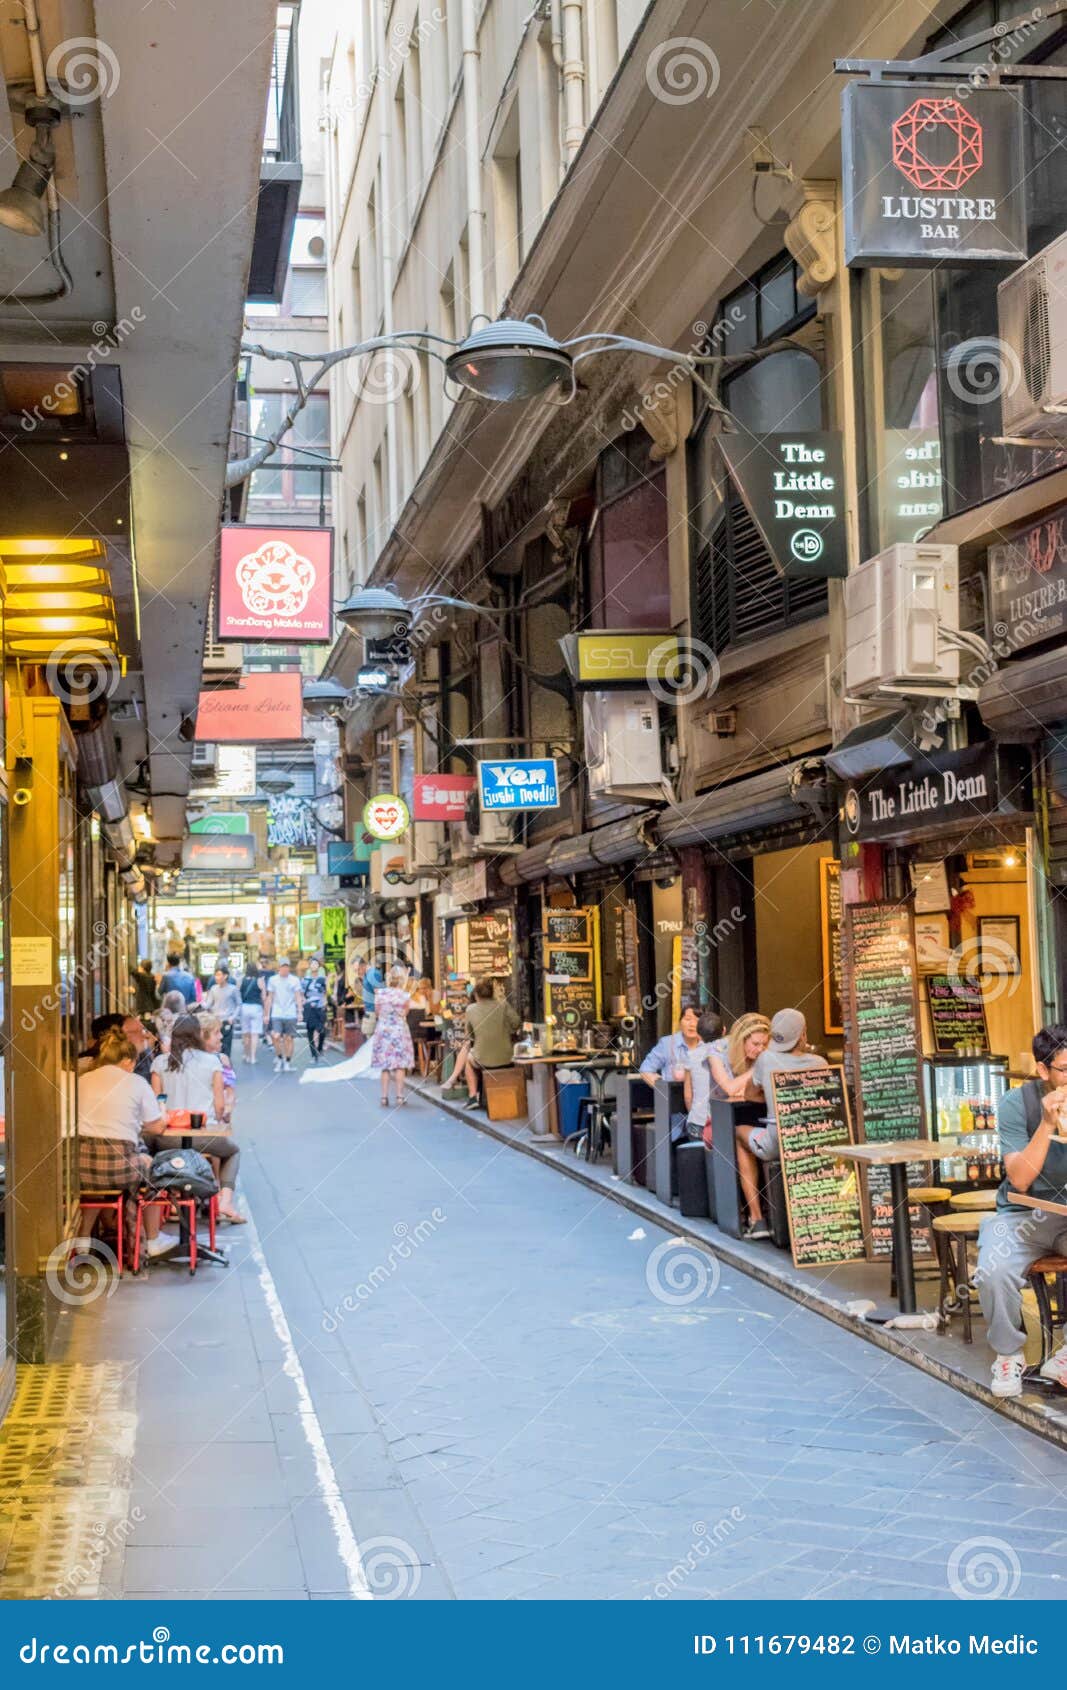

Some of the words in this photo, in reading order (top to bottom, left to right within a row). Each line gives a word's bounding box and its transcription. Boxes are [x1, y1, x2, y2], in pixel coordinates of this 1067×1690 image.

[882, 196, 996, 220] LUSTRE
[920, 224, 960, 239] BAR
[781, 443, 825, 463] The
[773, 471, 835, 491] Little
[774, 500, 836, 518] Denn
[1010, 583, 1056, 623] LUSTRE
[303, 620, 323, 629] mini
[488, 766, 548, 787] Yen
[484, 787, 515, 806] Sushi
[868, 788, 896, 821] The
[899, 777, 938, 815] Little
[942, 770, 988, 805] Denn
